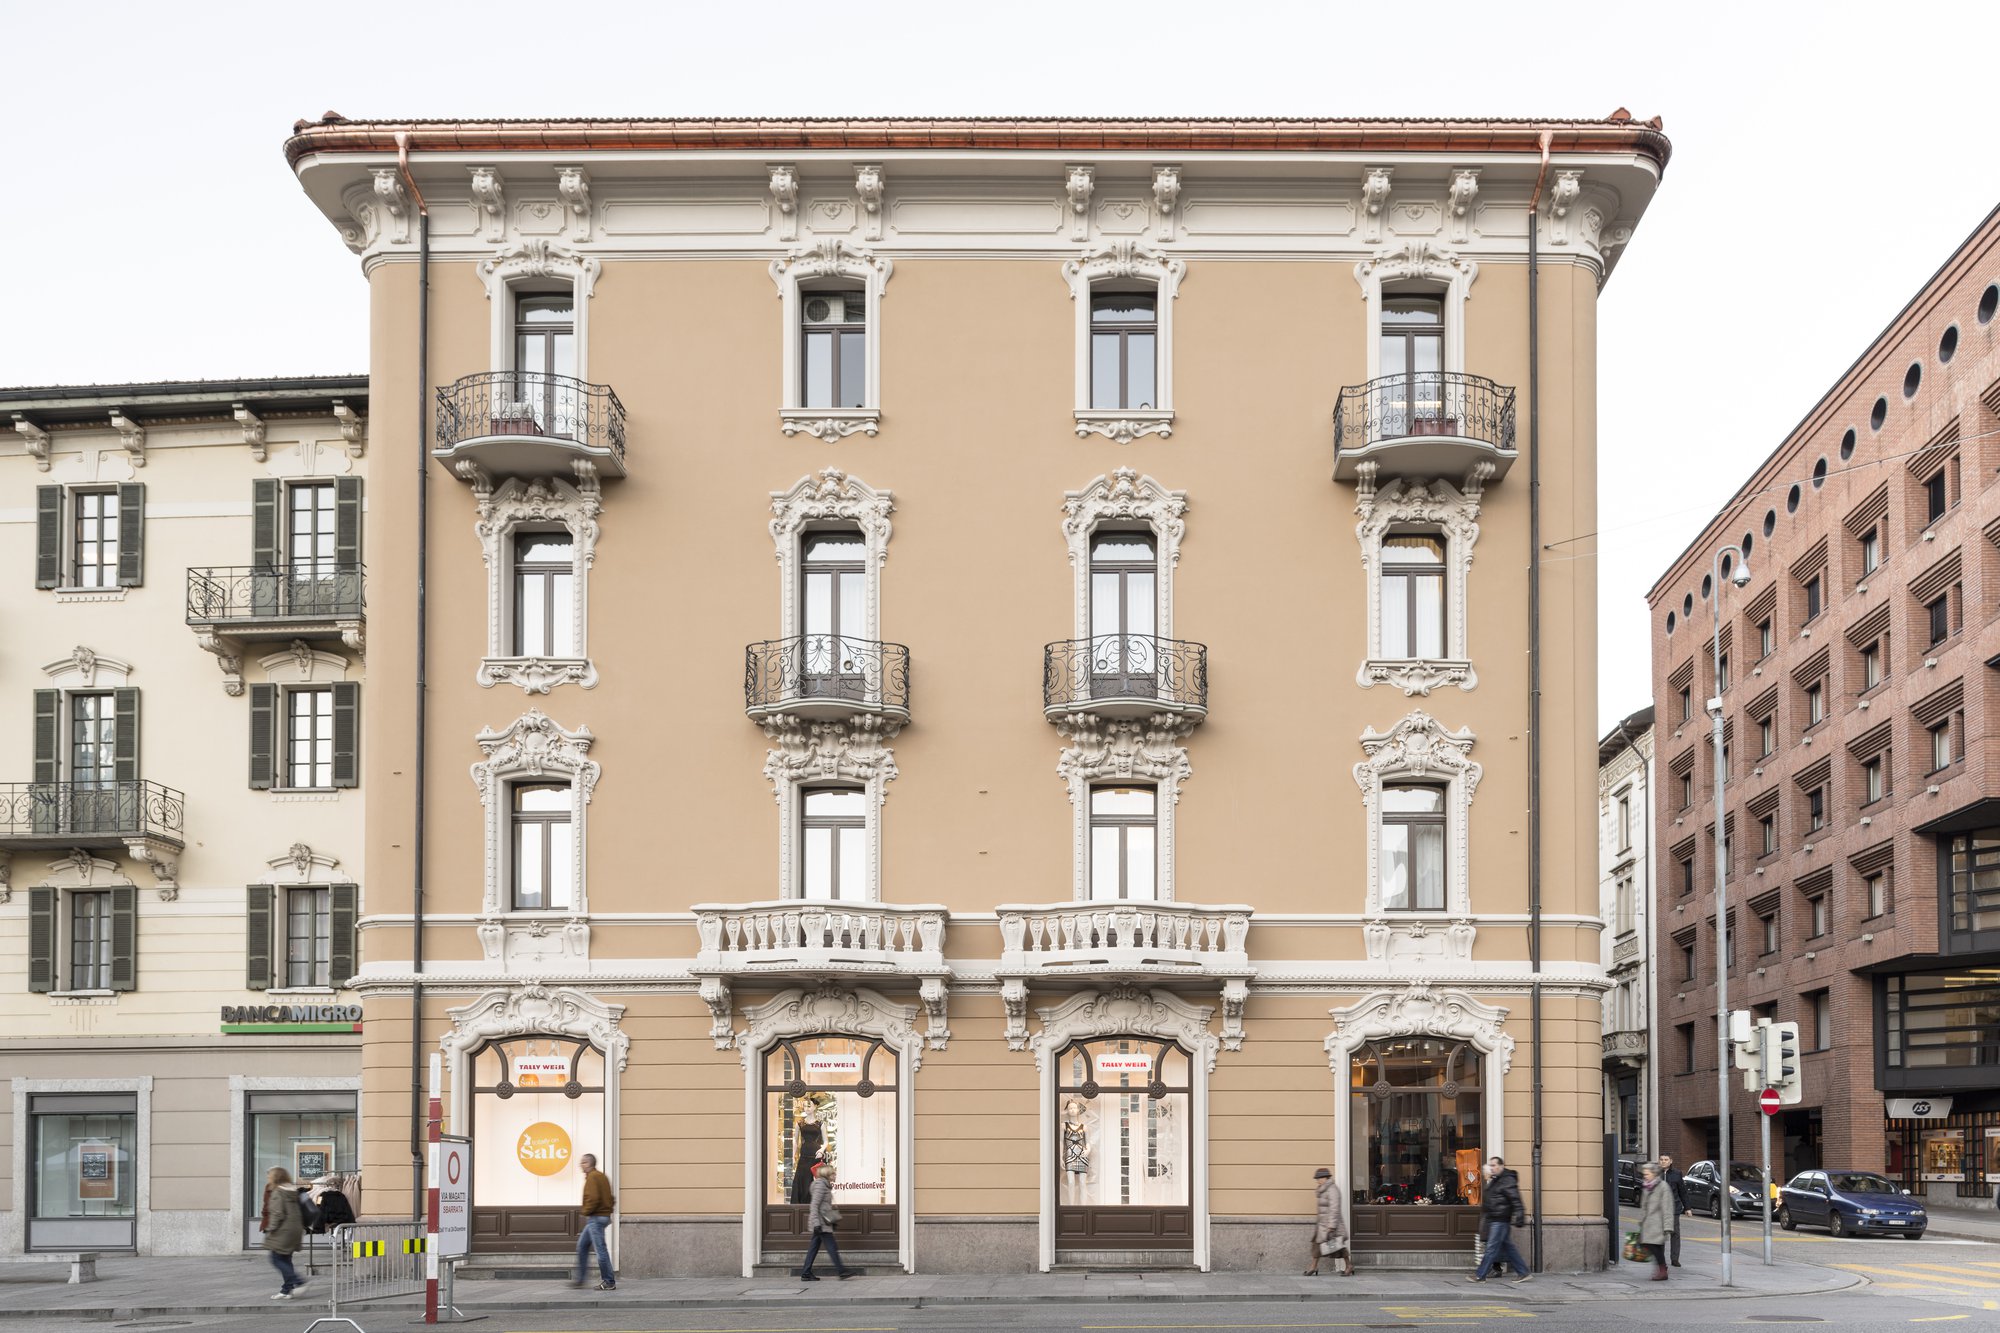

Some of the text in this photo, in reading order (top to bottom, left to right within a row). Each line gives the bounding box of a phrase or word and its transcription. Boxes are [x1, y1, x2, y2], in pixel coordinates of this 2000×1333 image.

[1913, 1104, 1931, 1112] ISS
[1408, 1119, 1457, 1132] ROMA
[520, 1144, 569, 1159] Sale
